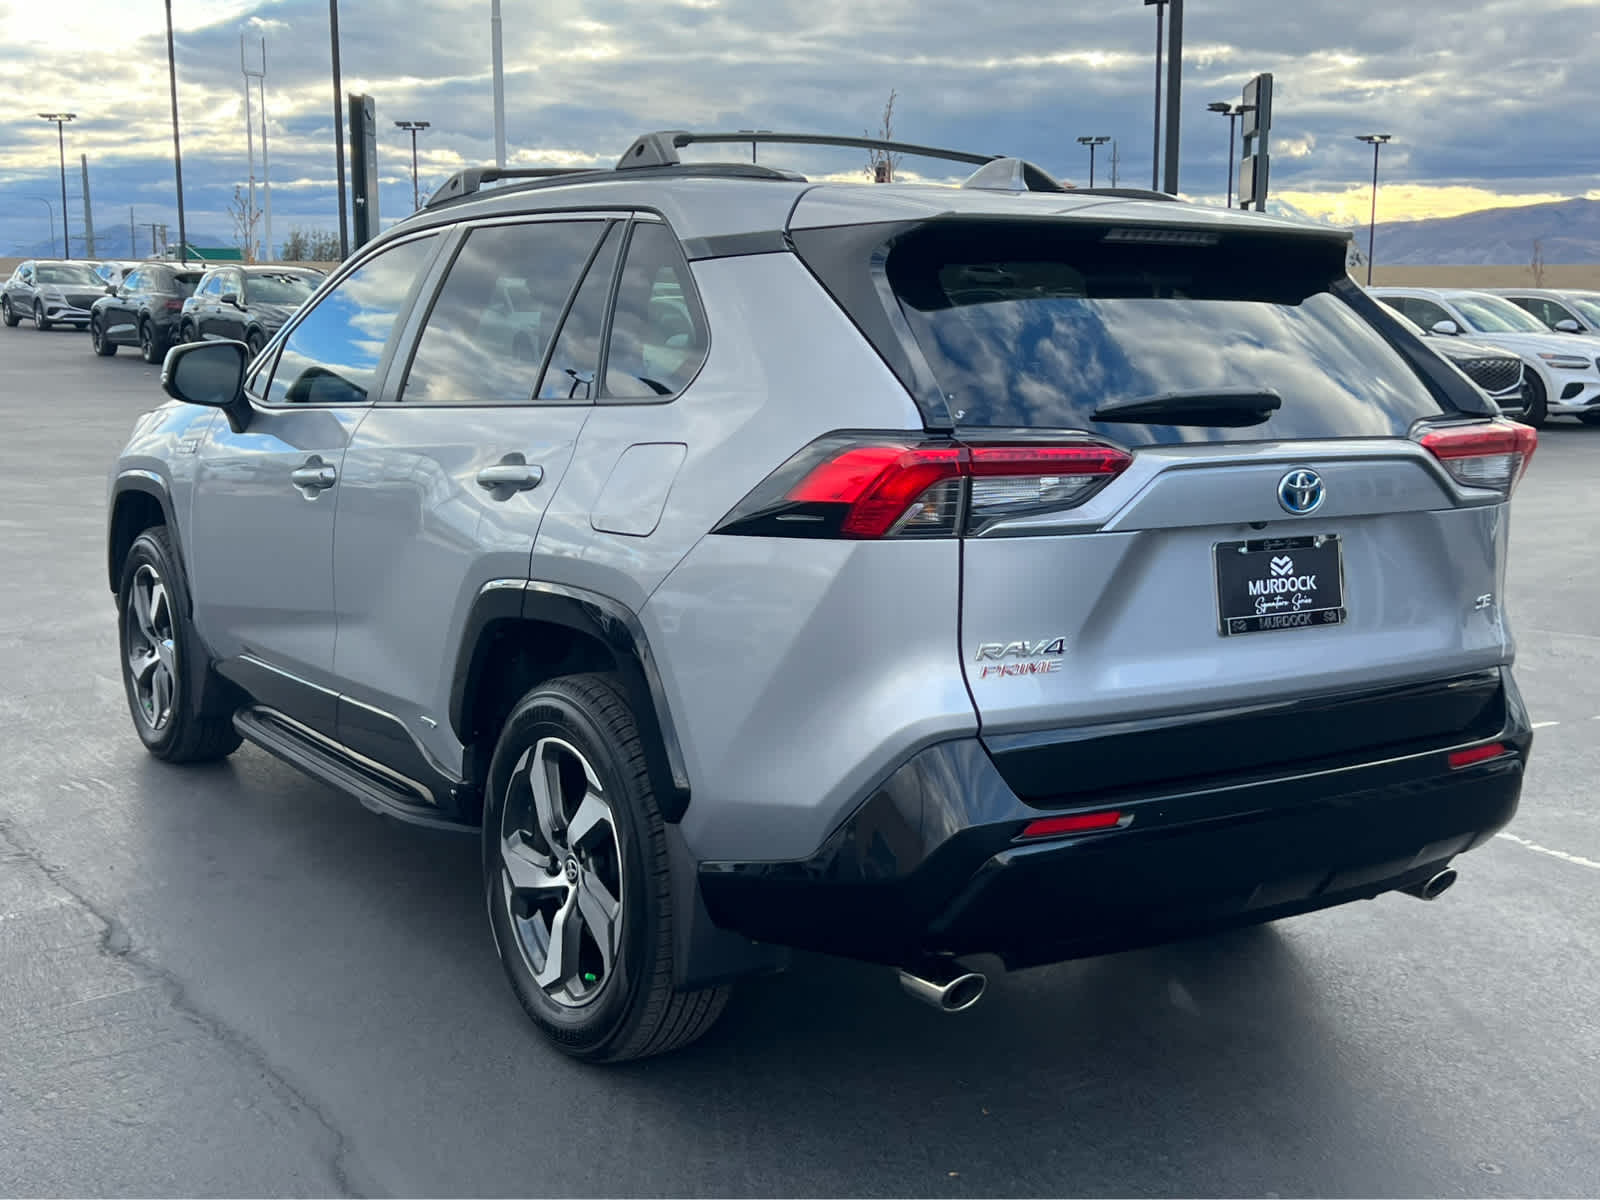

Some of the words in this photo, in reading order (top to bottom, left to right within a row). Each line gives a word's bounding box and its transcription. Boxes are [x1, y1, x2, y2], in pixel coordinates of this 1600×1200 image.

[1248, 575, 1317, 596] MURDOCK
[1259, 613, 1313, 629] MURDOCK
[976, 636, 1066, 661] RAV4
[981, 659, 1063, 678] PRIME
